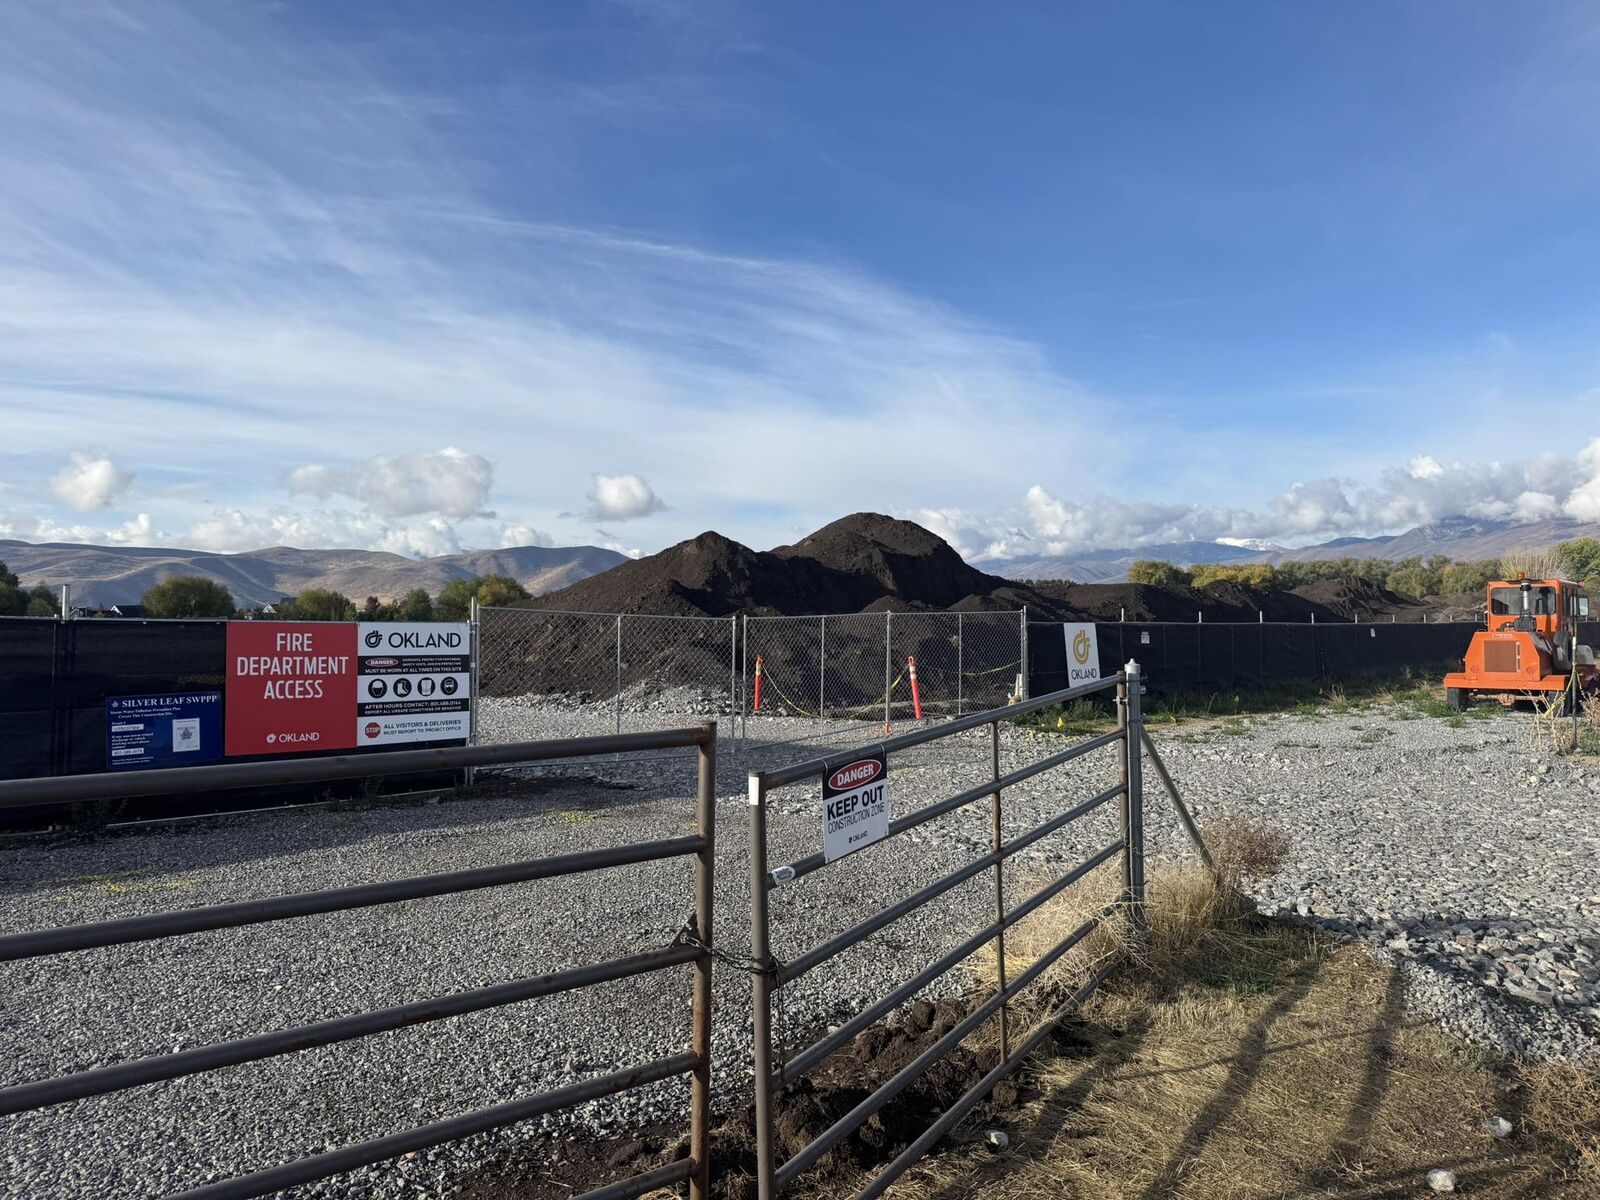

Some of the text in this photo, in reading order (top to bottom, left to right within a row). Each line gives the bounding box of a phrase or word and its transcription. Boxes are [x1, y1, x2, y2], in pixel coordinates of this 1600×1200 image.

[276, 633, 313, 652] FIRE
[388, 632, 461, 648] OKLAND
[236, 656, 349, 676] DEPARTMENT
[1071, 668, 1097, 680] OKLAND
[263, 680, 324, 700] ACCESS
[122, 695, 217, 707] SILVER LEAF SWPPP
[403, 701, 430, 709] CONTACT:
[429, 719, 462, 727] DELIVERIES
[278, 732, 320, 743] OKLAND
[837, 764, 874, 786] DANGER
[827, 785, 884, 821] KEEP OUT
[828, 802, 885, 834] CONSTRUCTION ZONE
